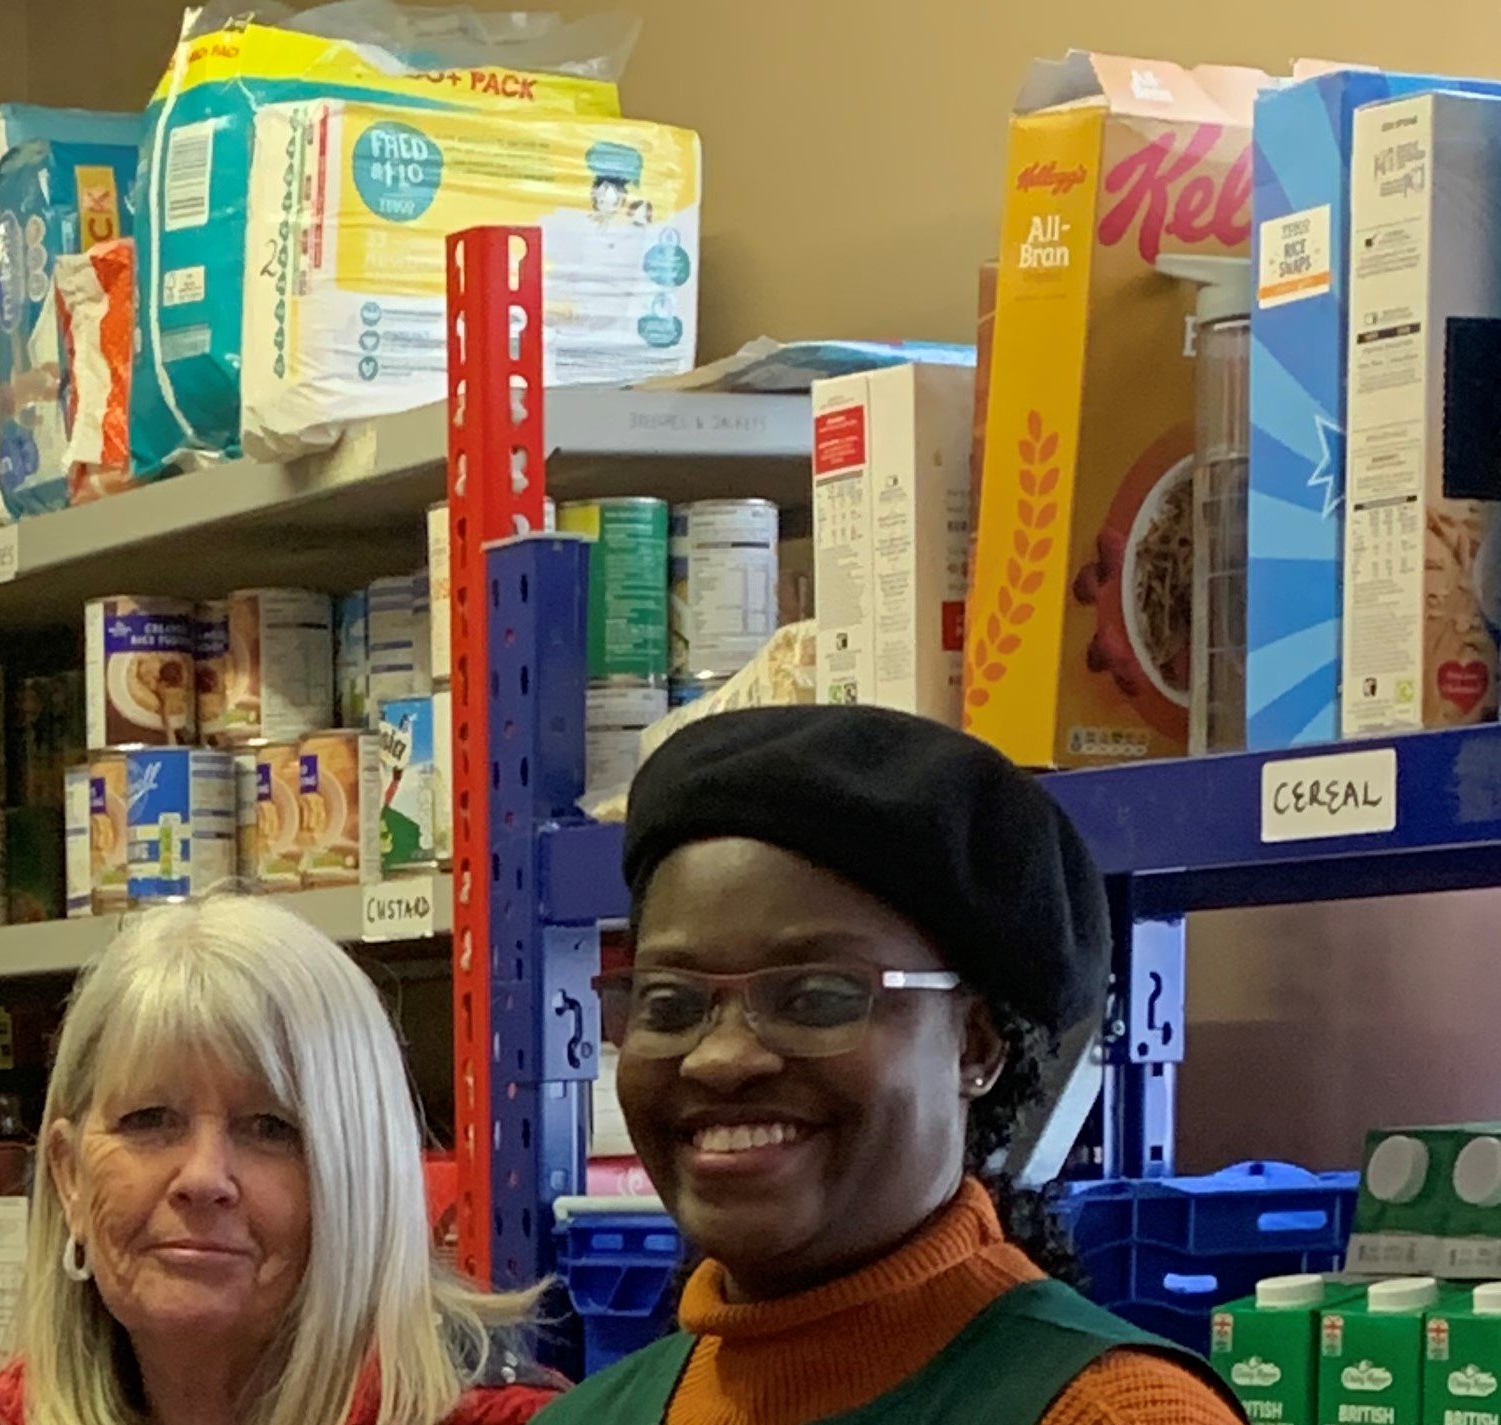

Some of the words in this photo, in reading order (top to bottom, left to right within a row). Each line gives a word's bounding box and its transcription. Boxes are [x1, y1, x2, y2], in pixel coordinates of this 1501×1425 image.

[470, 71, 538, 102] PACK
[370, 129, 428, 161] FRED
[1098, 122, 1253, 266] Kel
[1027, 214, 1071, 243] All-
[1018, 243, 1070, 269] Bran
[1284, 238, 1307, 258] RICE
[1274, 780, 1382, 815] CEREAL
[367, 896, 430, 924] CUSTARD
[1338, 1404, 1395, 1425] BRITISH
